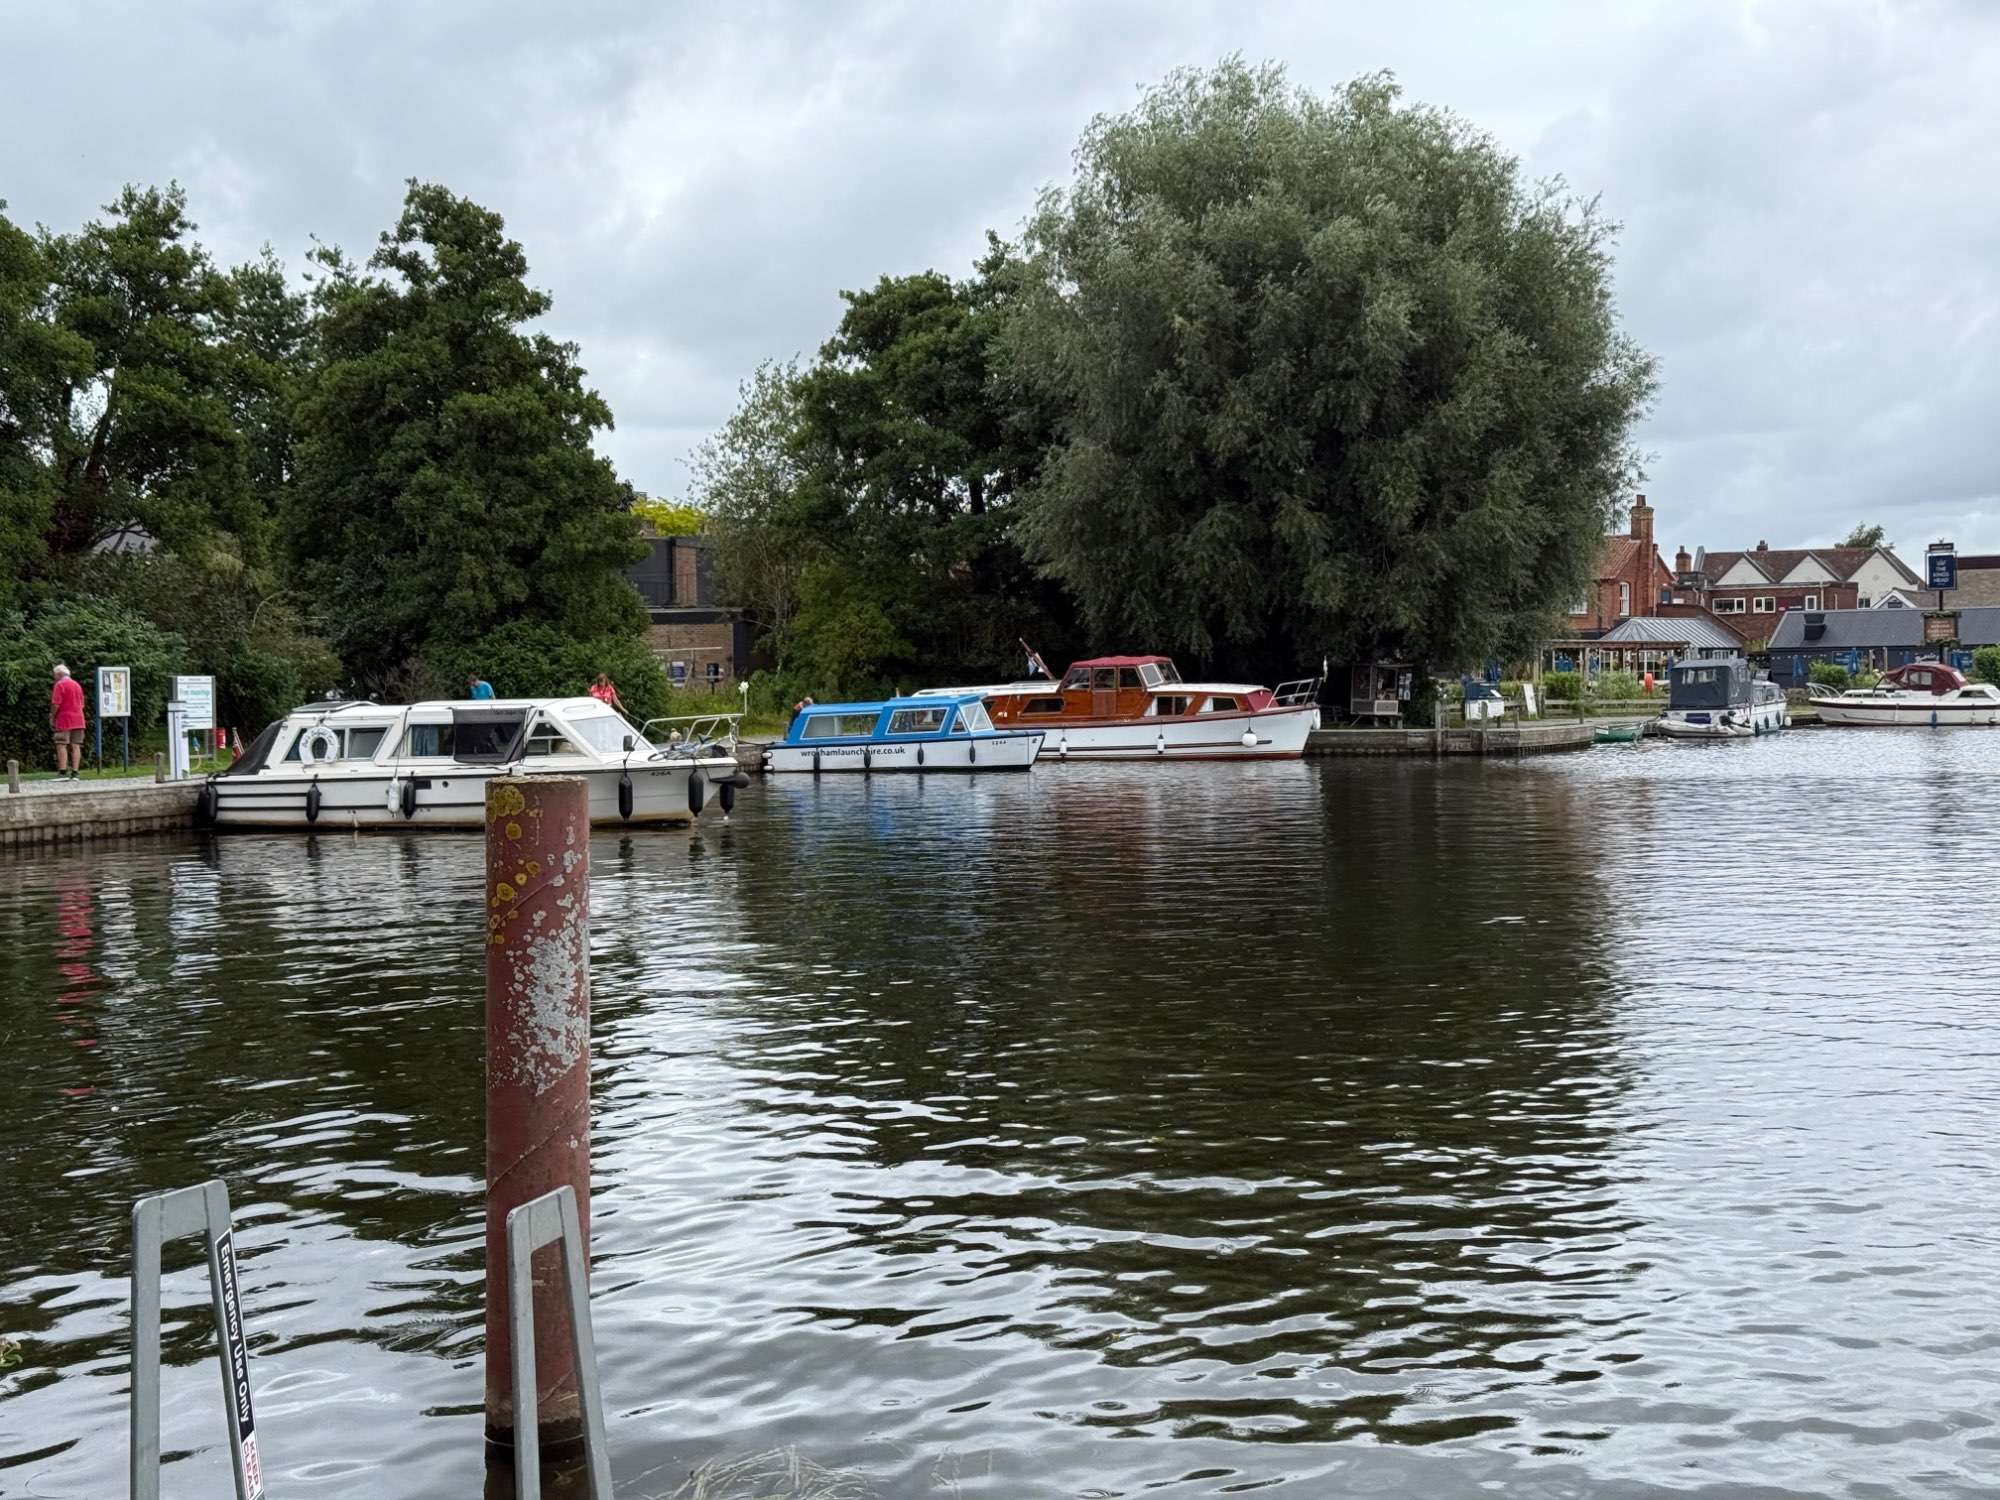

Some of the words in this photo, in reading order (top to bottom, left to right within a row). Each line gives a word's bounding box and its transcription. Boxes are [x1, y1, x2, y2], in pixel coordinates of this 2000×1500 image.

[801, 746, 906, 758] wrohamlaunchire.co.uk
[220, 1243, 240, 1340] Emergency
[233, 1343, 245, 1380] Use
[238, 1380, 250, 1423] Only
[243, 1441, 255, 1499] CLEAR
[249, 1440, 259, 1487] KEEP
